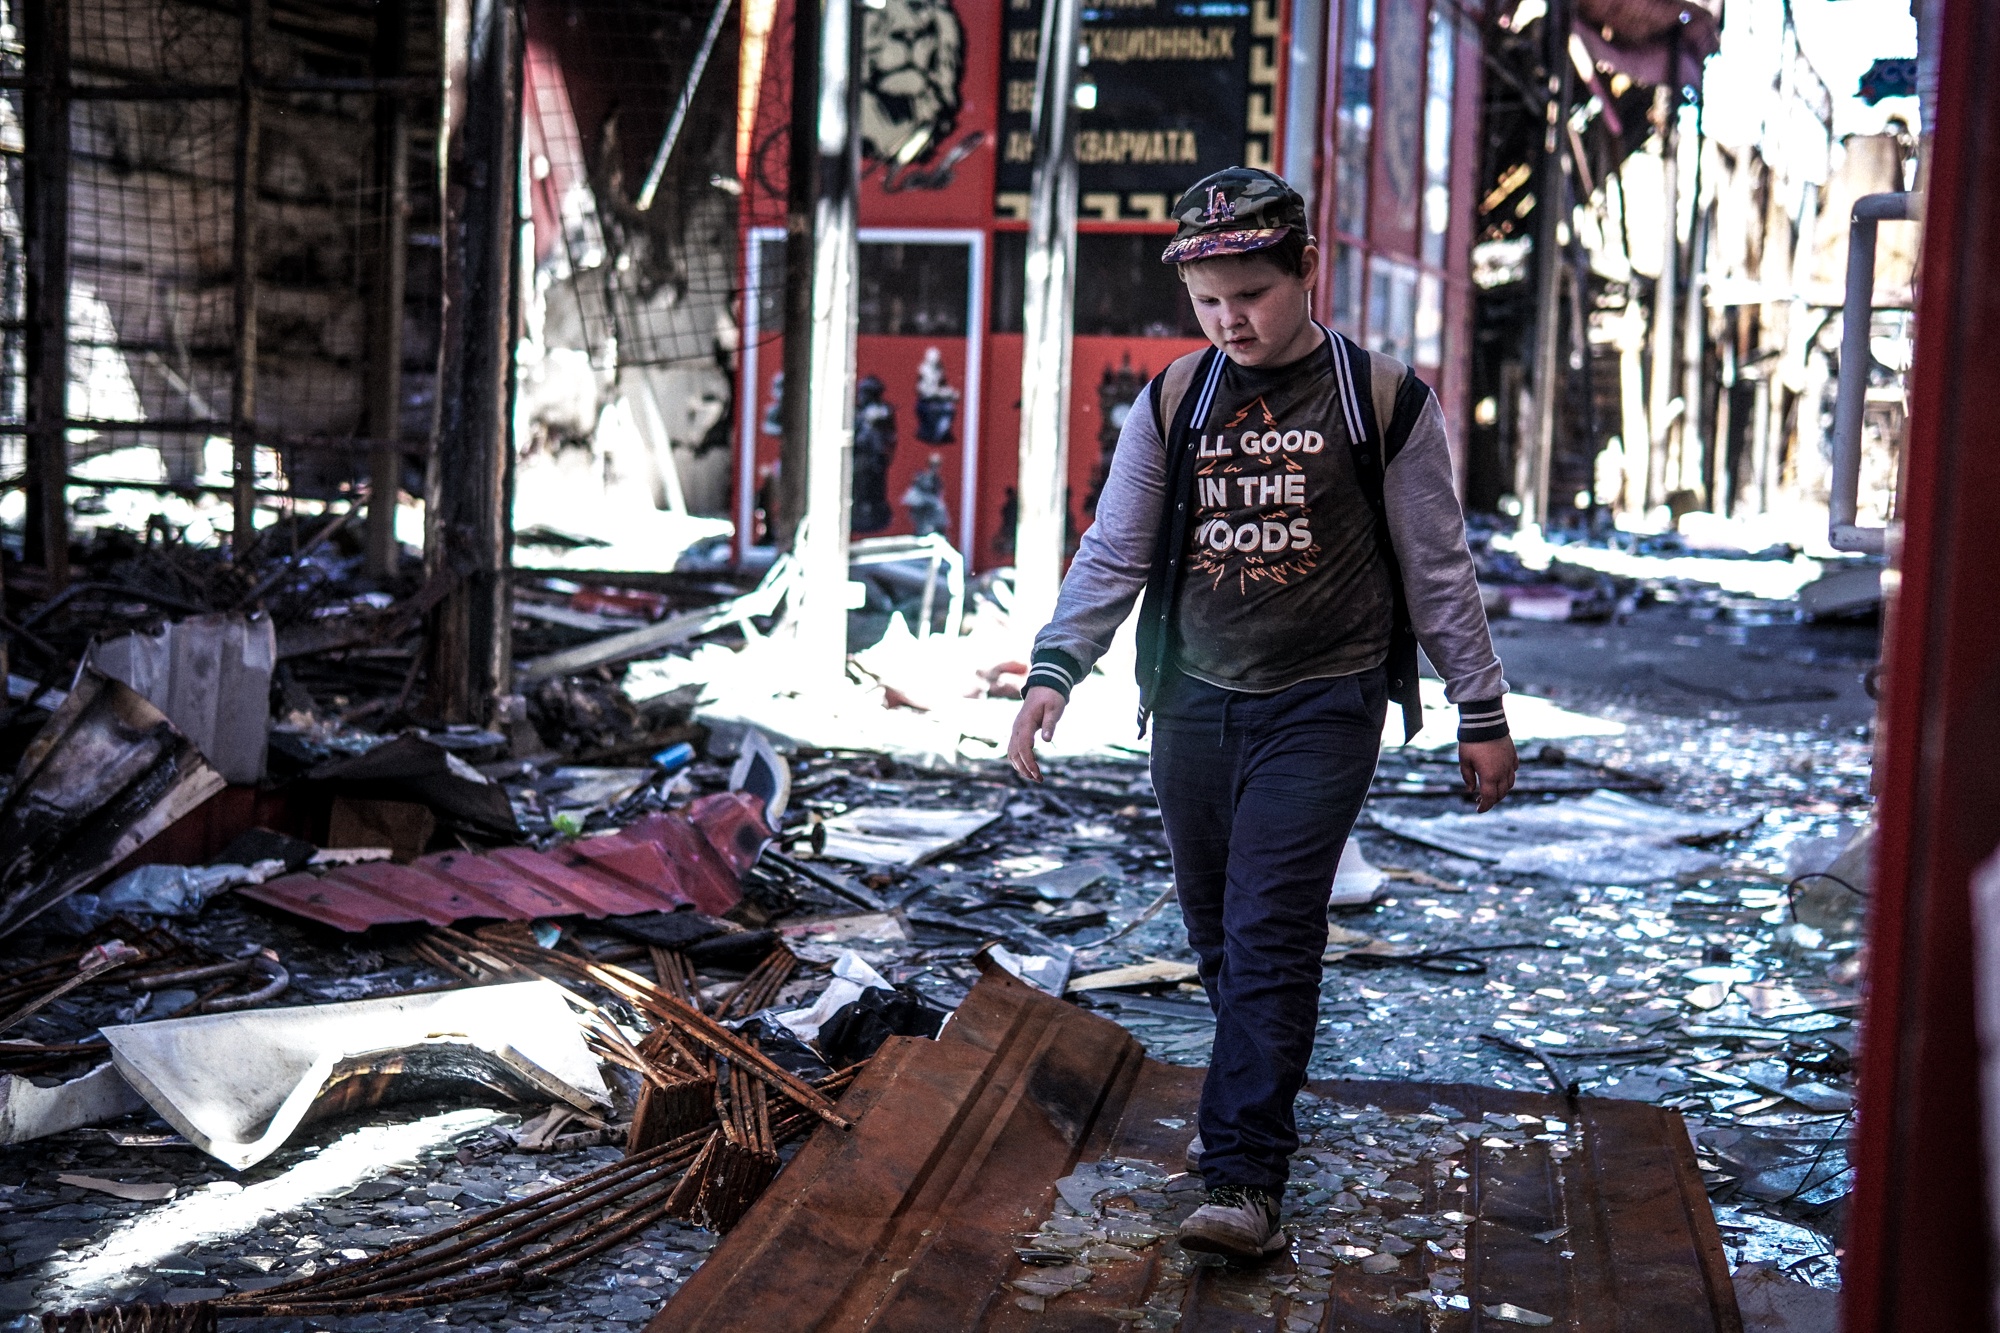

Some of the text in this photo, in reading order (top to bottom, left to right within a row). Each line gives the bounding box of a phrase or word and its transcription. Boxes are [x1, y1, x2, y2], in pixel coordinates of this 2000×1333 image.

[1009, 28, 1236, 61] КОКЦИОННЫХ
[1005, 131, 1197, 163] АНКВАРИАТА
[1203, 185, 1235, 225] LA
[1196, 430, 1325, 459] LL GOOD
[1198, 474, 1306, 508] IN THE
